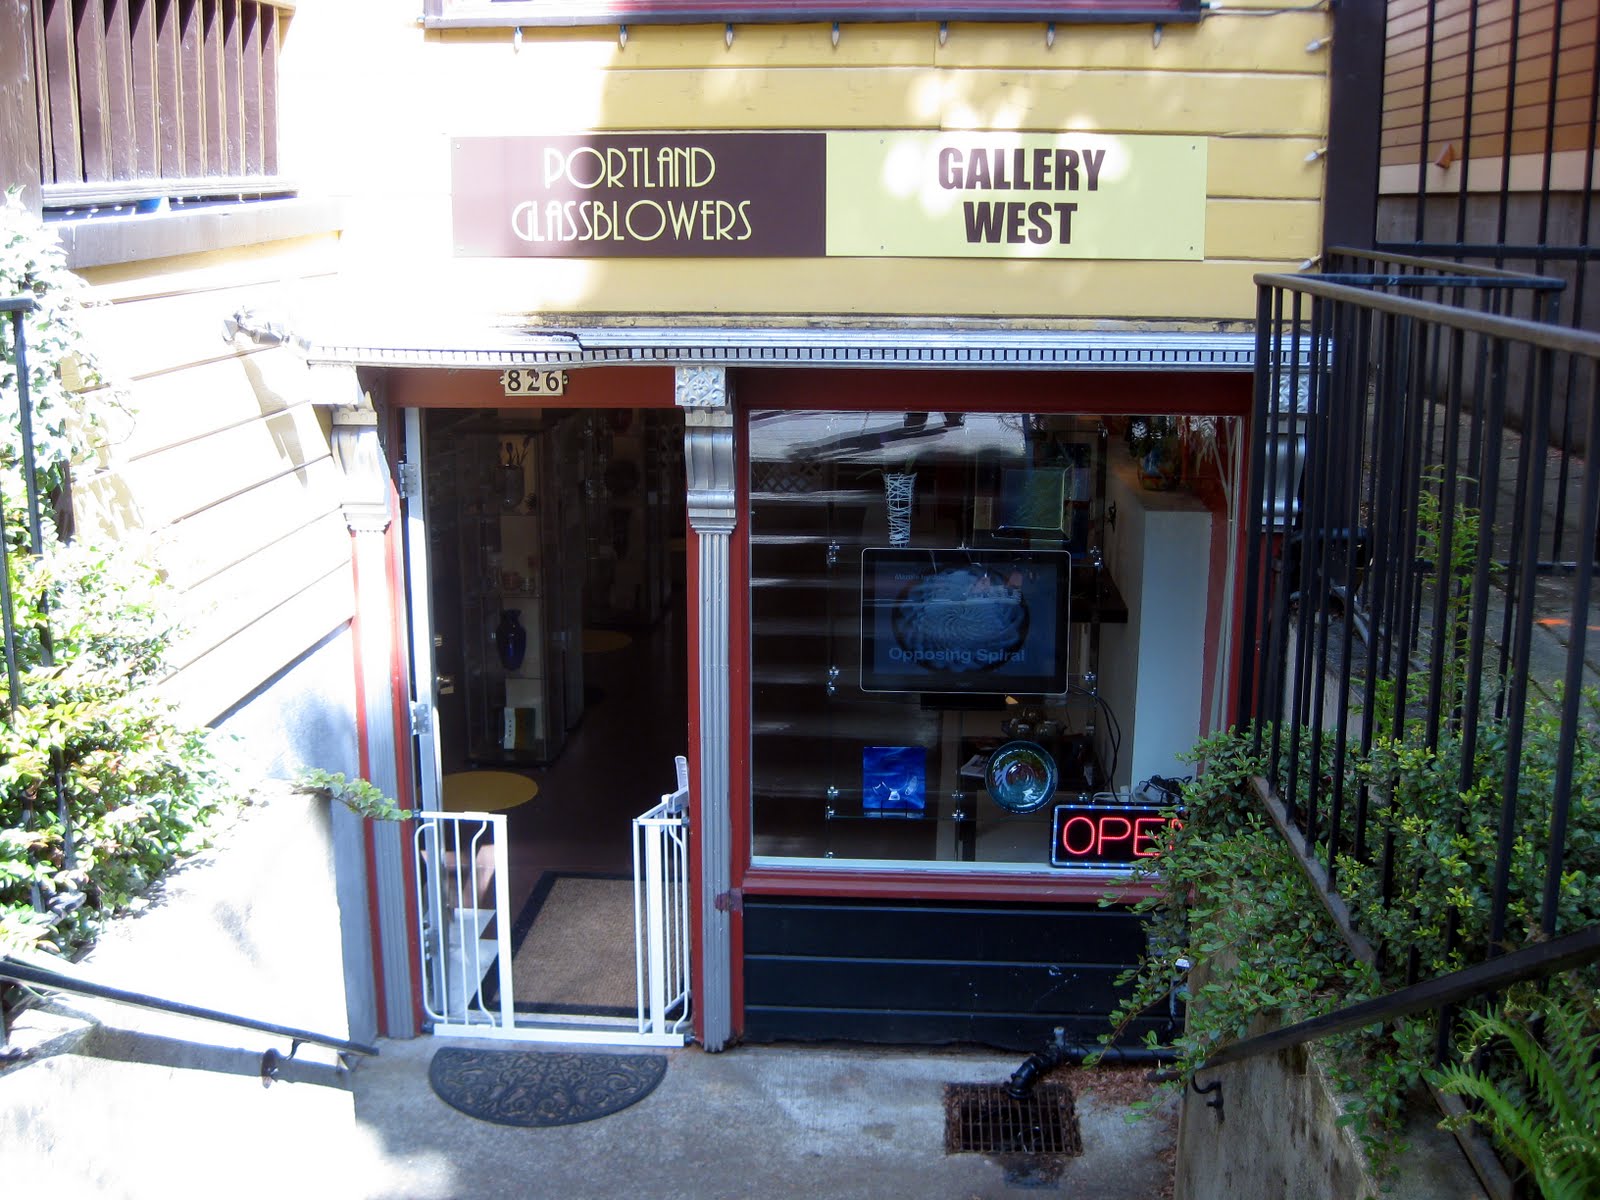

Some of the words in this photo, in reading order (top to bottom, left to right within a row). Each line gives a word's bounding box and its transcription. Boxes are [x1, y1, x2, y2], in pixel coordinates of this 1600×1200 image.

[543, 146, 716, 189] PORTLAND
[938, 147, 1106, 191] GALLERY
[511, 199, 752, 241] GLASSBLOWERS
[963, 201, 1078, 244] WEST
[507, 369, 560, 392] 826
[888, 647, 972, 664] Opposing
[976, 648, 1026, 664] Spiral
